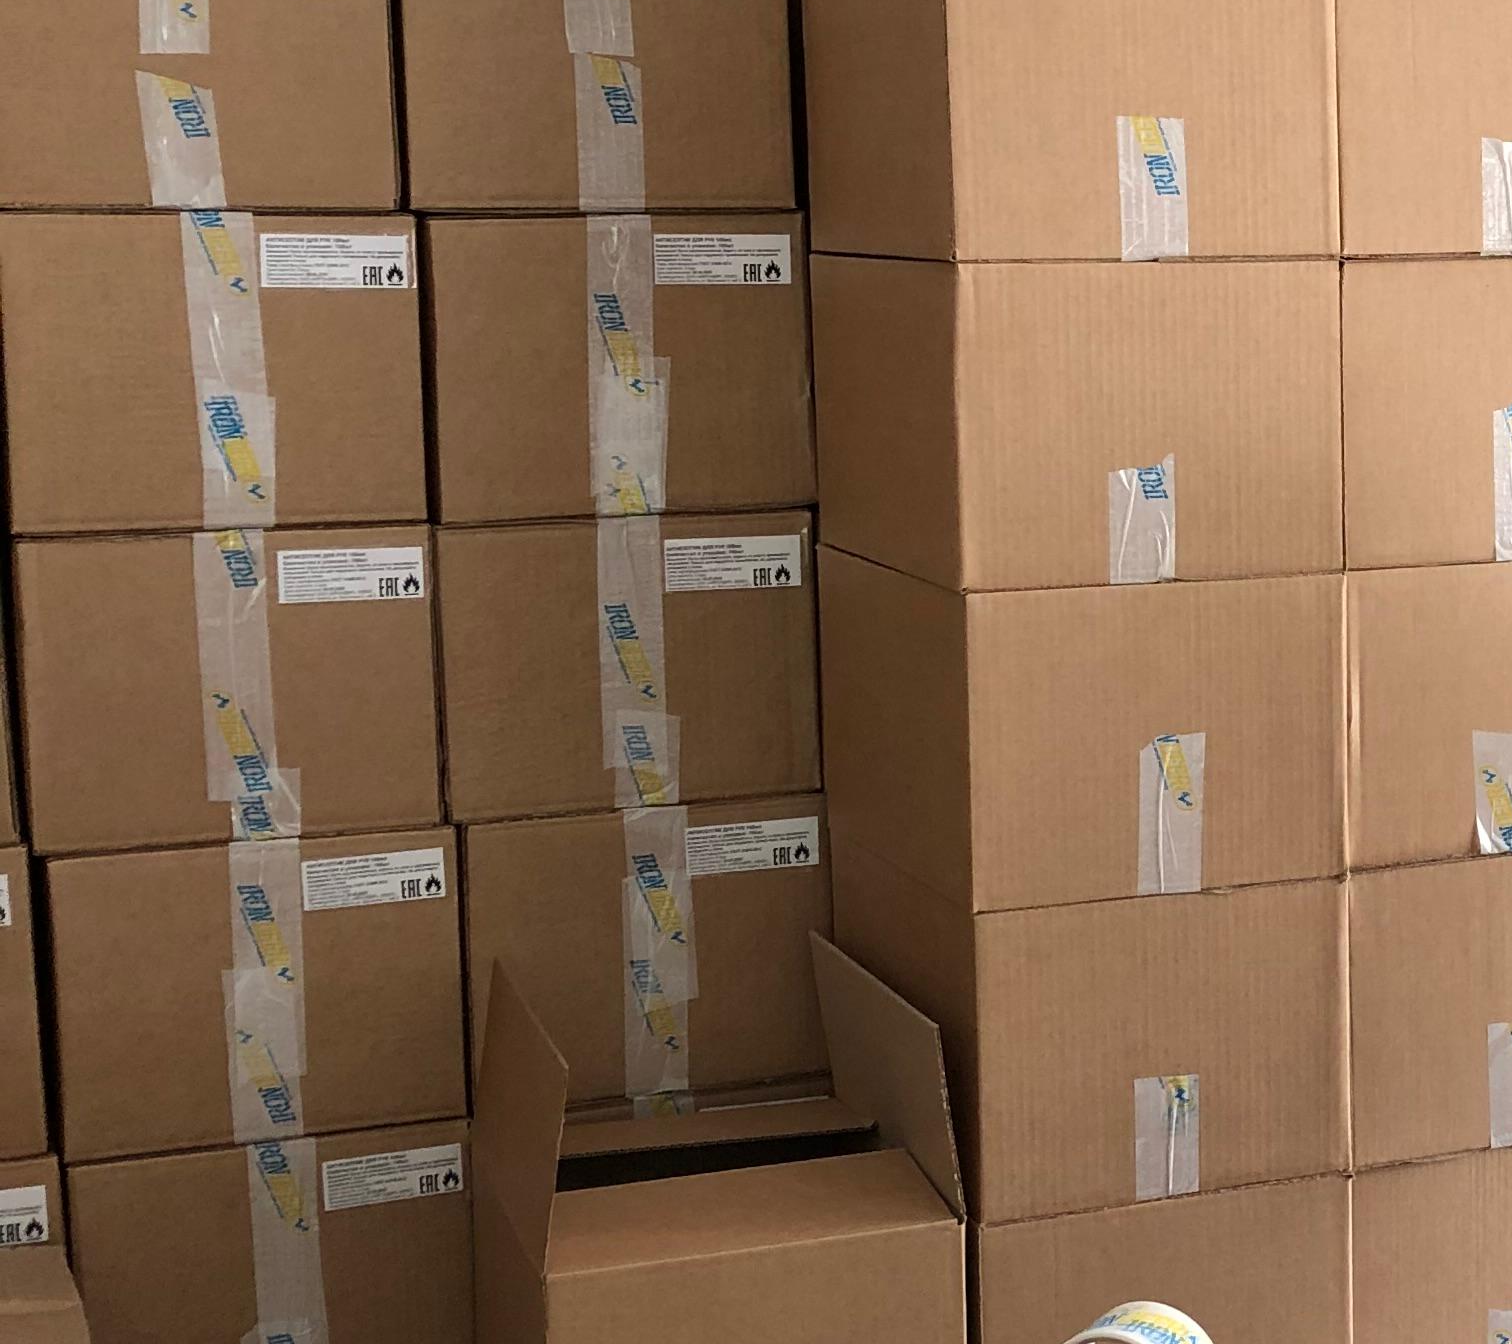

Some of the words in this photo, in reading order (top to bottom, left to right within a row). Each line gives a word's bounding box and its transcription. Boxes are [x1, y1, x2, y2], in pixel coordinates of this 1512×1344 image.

[169, 96, 211, 140] IRON
[602, 84, 638, 125] IRON
[1144, 152, 1180, 197] IRON
[593, 292, 628, 332] IRON
[223, 549, 258, 589] IRON
[604, 602, 640, 641] IRON
[622, 724, 655, 762] IRON
[236, 754, 271, 792] IRON
[632, 854, 666, 888] IRON
[237, 884, 276, 923] IRON
[259, 1087, 297, 1123] IRON
